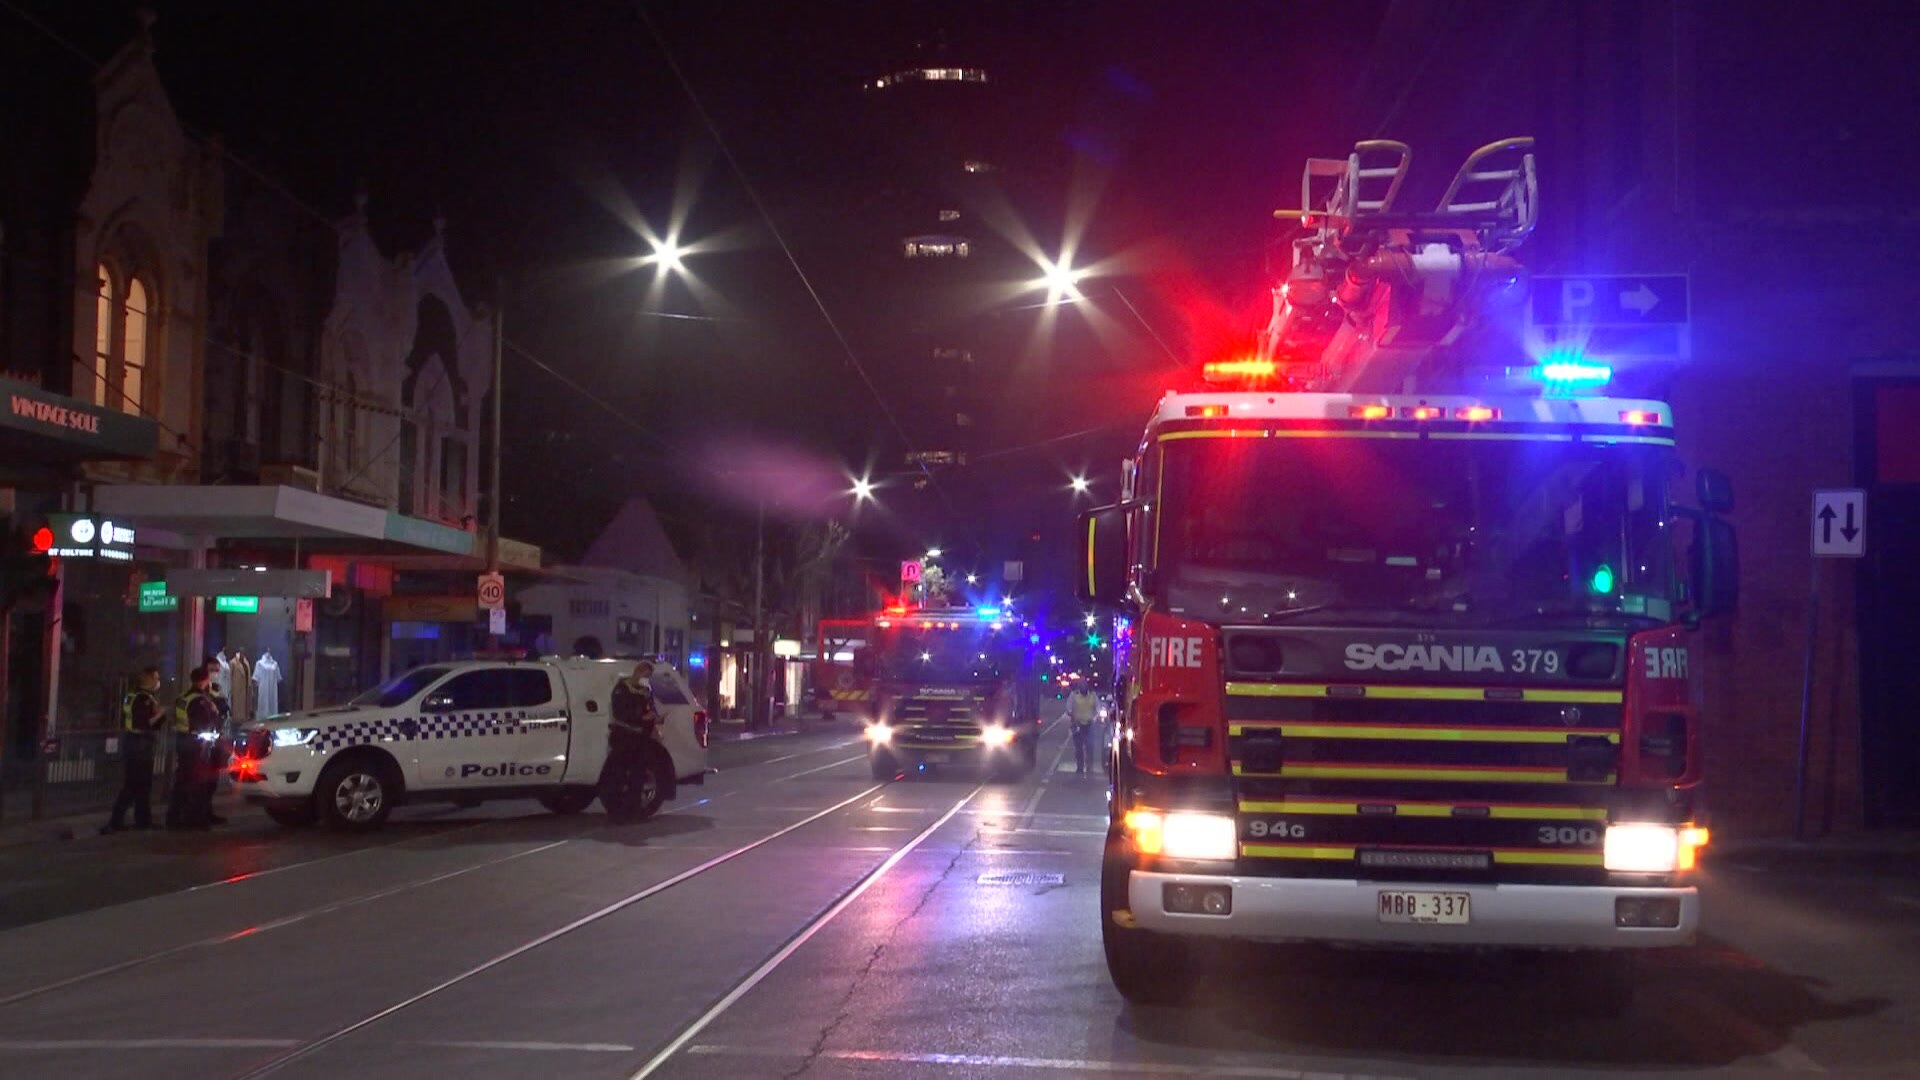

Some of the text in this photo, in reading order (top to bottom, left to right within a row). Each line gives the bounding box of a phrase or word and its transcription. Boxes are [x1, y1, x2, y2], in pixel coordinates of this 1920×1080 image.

[1565, 281, 1595, 320] P
[11, 395, 101, 434] VINTAGE SOLE
[482, 585, 499, 599] 40
[1151, 637, 1203, 668] FIRE
[1344, 643, 1558, 673] SCANIA 379
[461, 762, 551, 778] Police
[1249, 820, 1305, 838] 94G
[1538, 826, 1598, 844] 300
